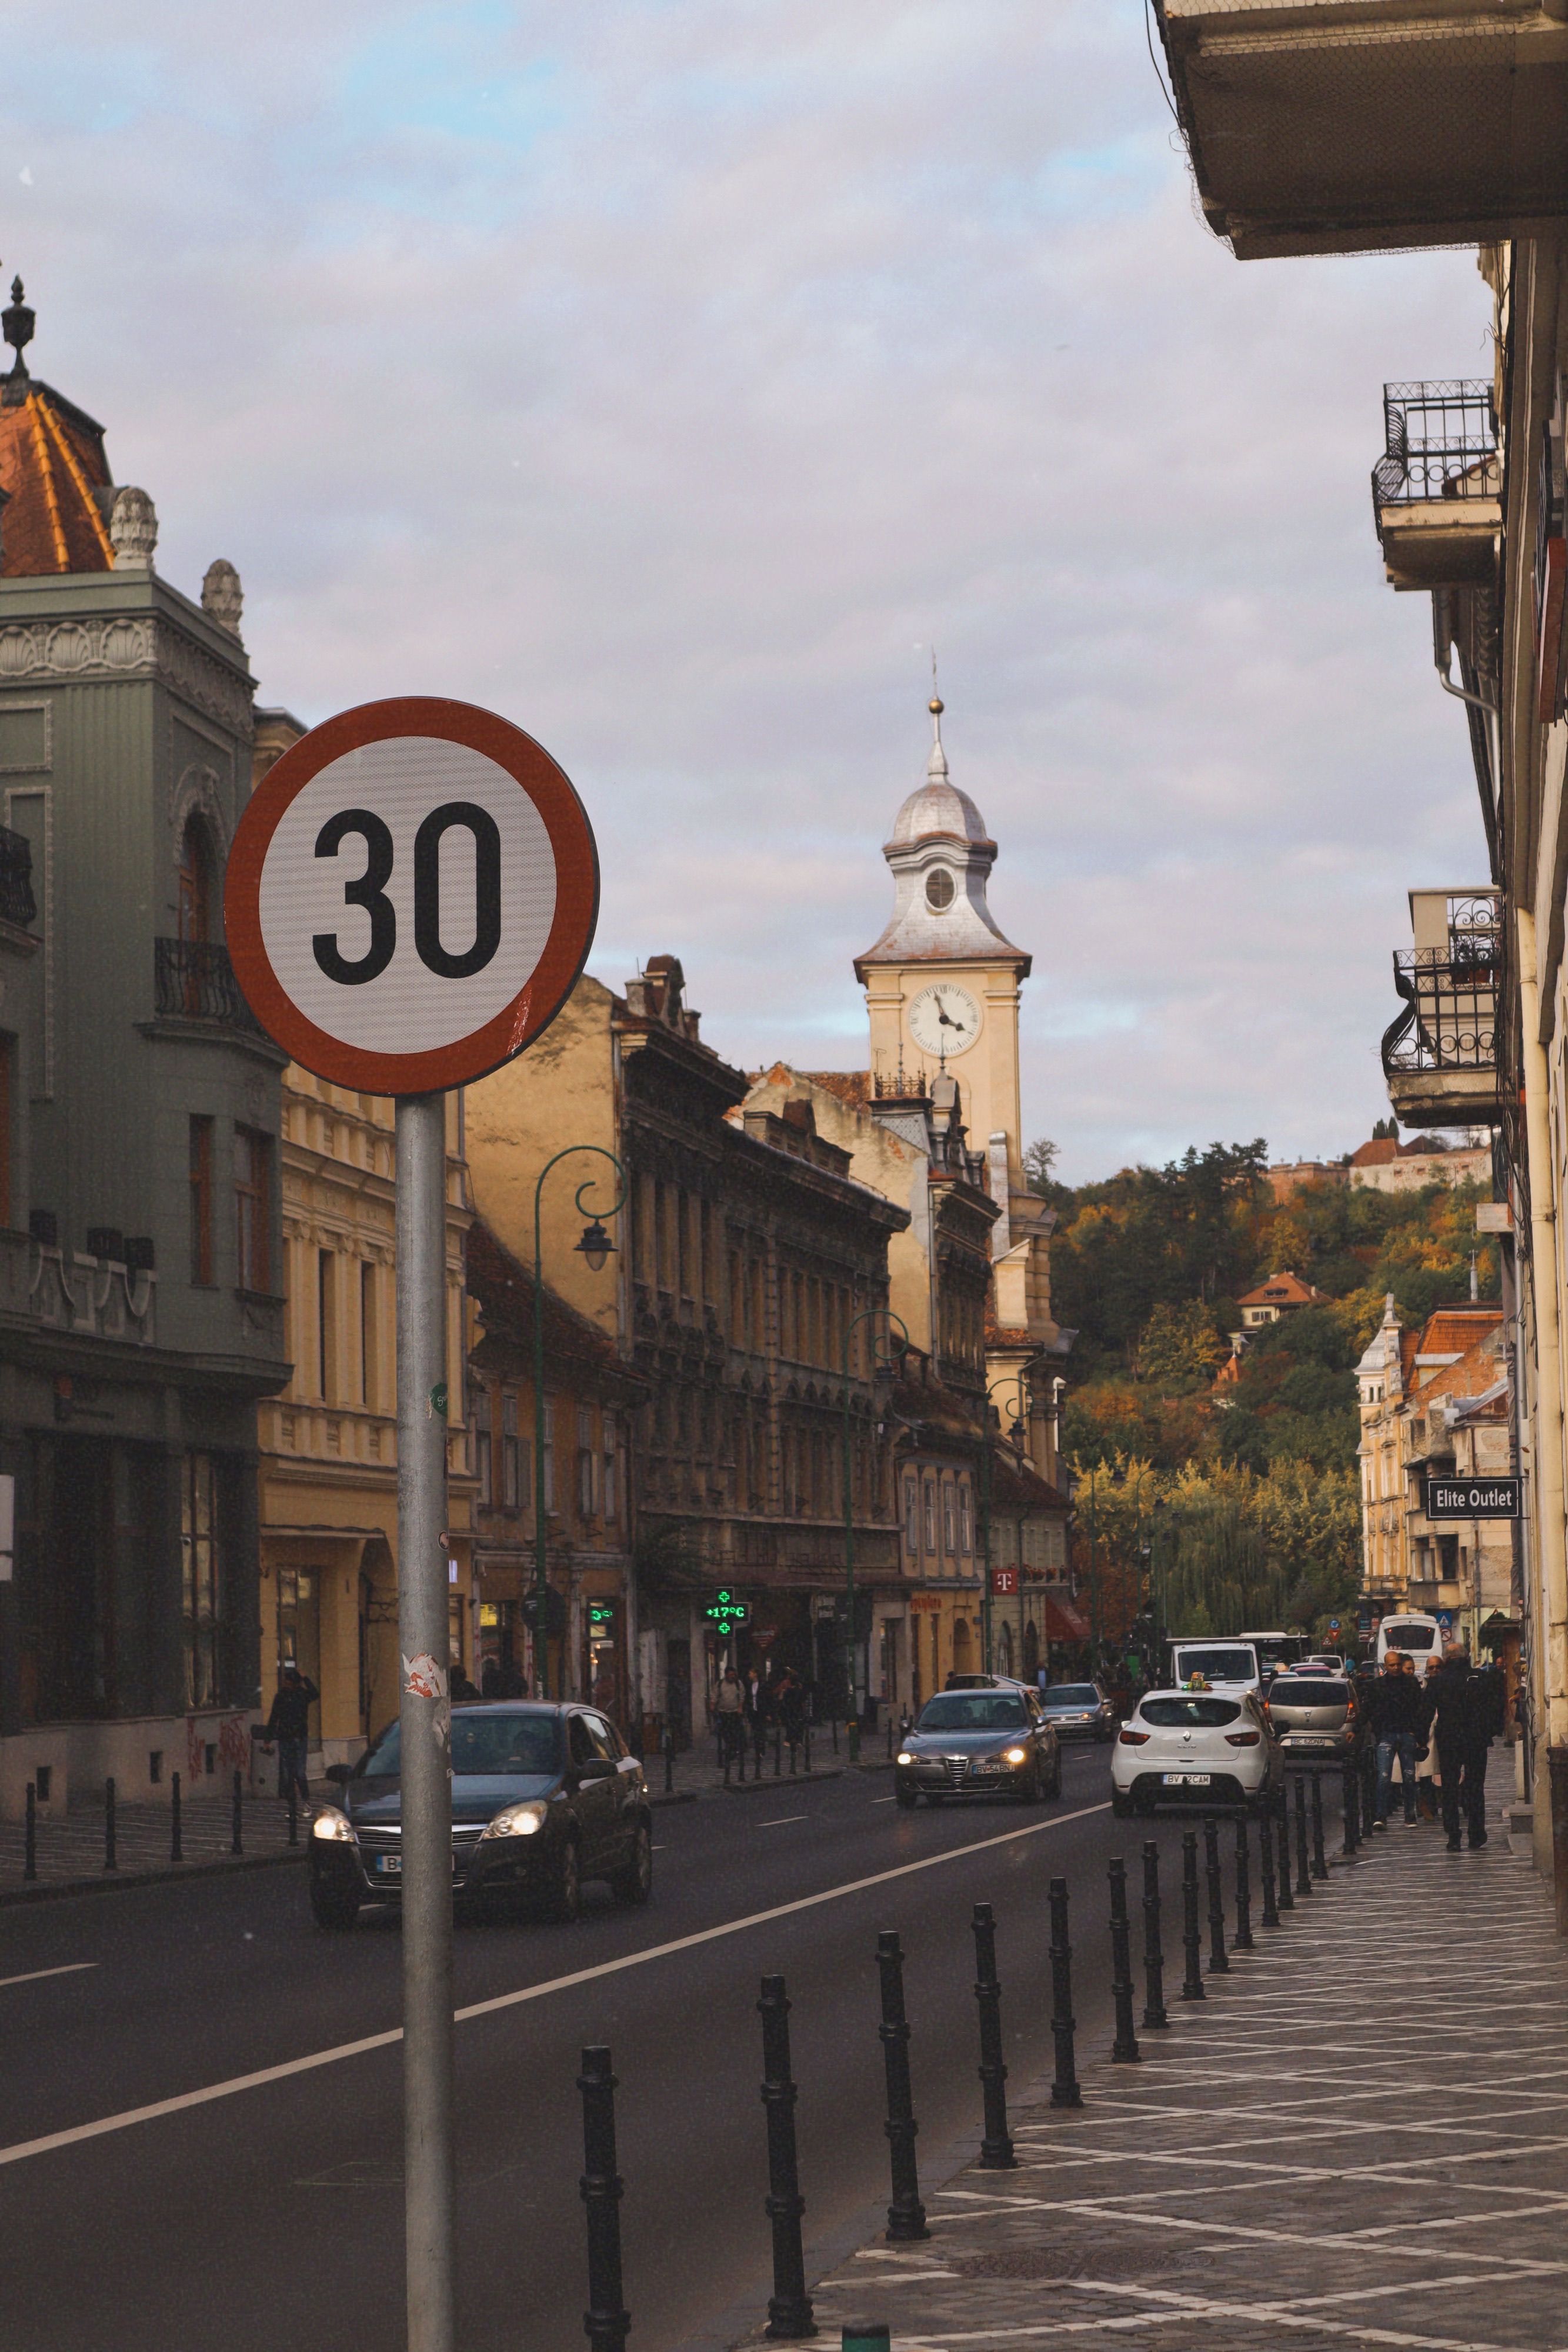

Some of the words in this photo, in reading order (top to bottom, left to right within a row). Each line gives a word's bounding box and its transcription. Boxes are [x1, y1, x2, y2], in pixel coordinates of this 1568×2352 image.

[312, 801, 501, 985] 30
[1437, 1489, 1465, 1507] Elite
[1469, 1488, 1512, 1507] Outlet
[997, 1573, 1012, 1590] T
